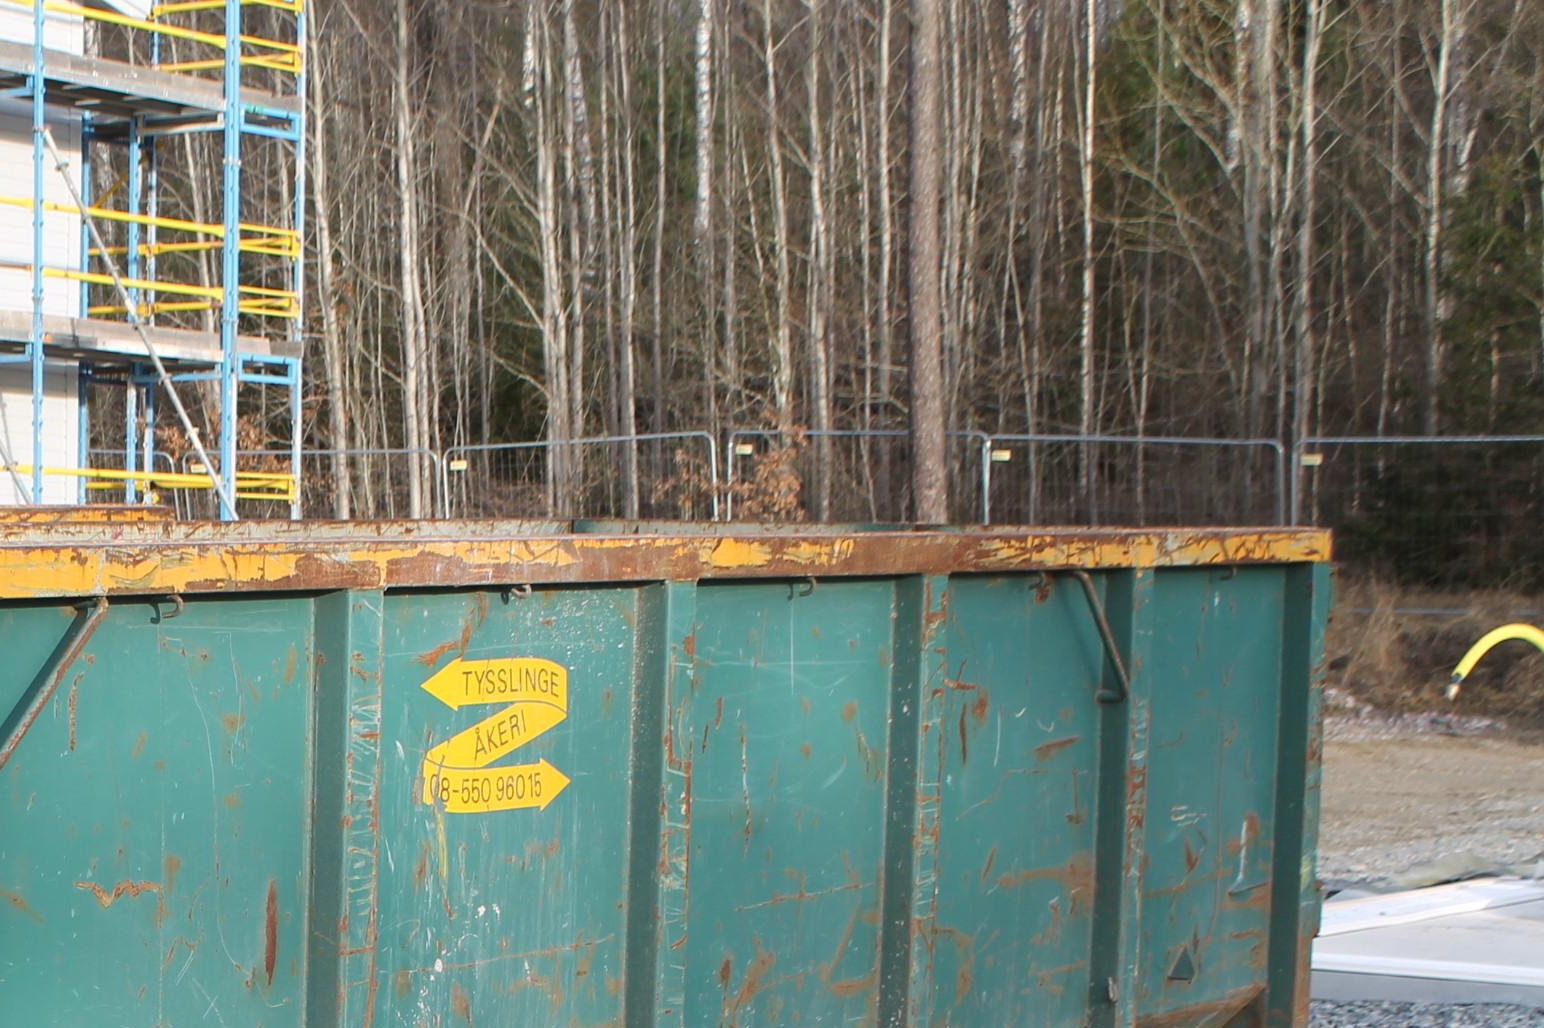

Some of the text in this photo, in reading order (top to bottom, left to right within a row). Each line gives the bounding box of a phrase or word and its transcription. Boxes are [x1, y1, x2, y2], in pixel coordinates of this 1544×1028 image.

[461, 667, 559, 698] TYSSLINGE
[473, 709, 527, 761] ÅKERI
[429, 773, 492, 804] 08-550
